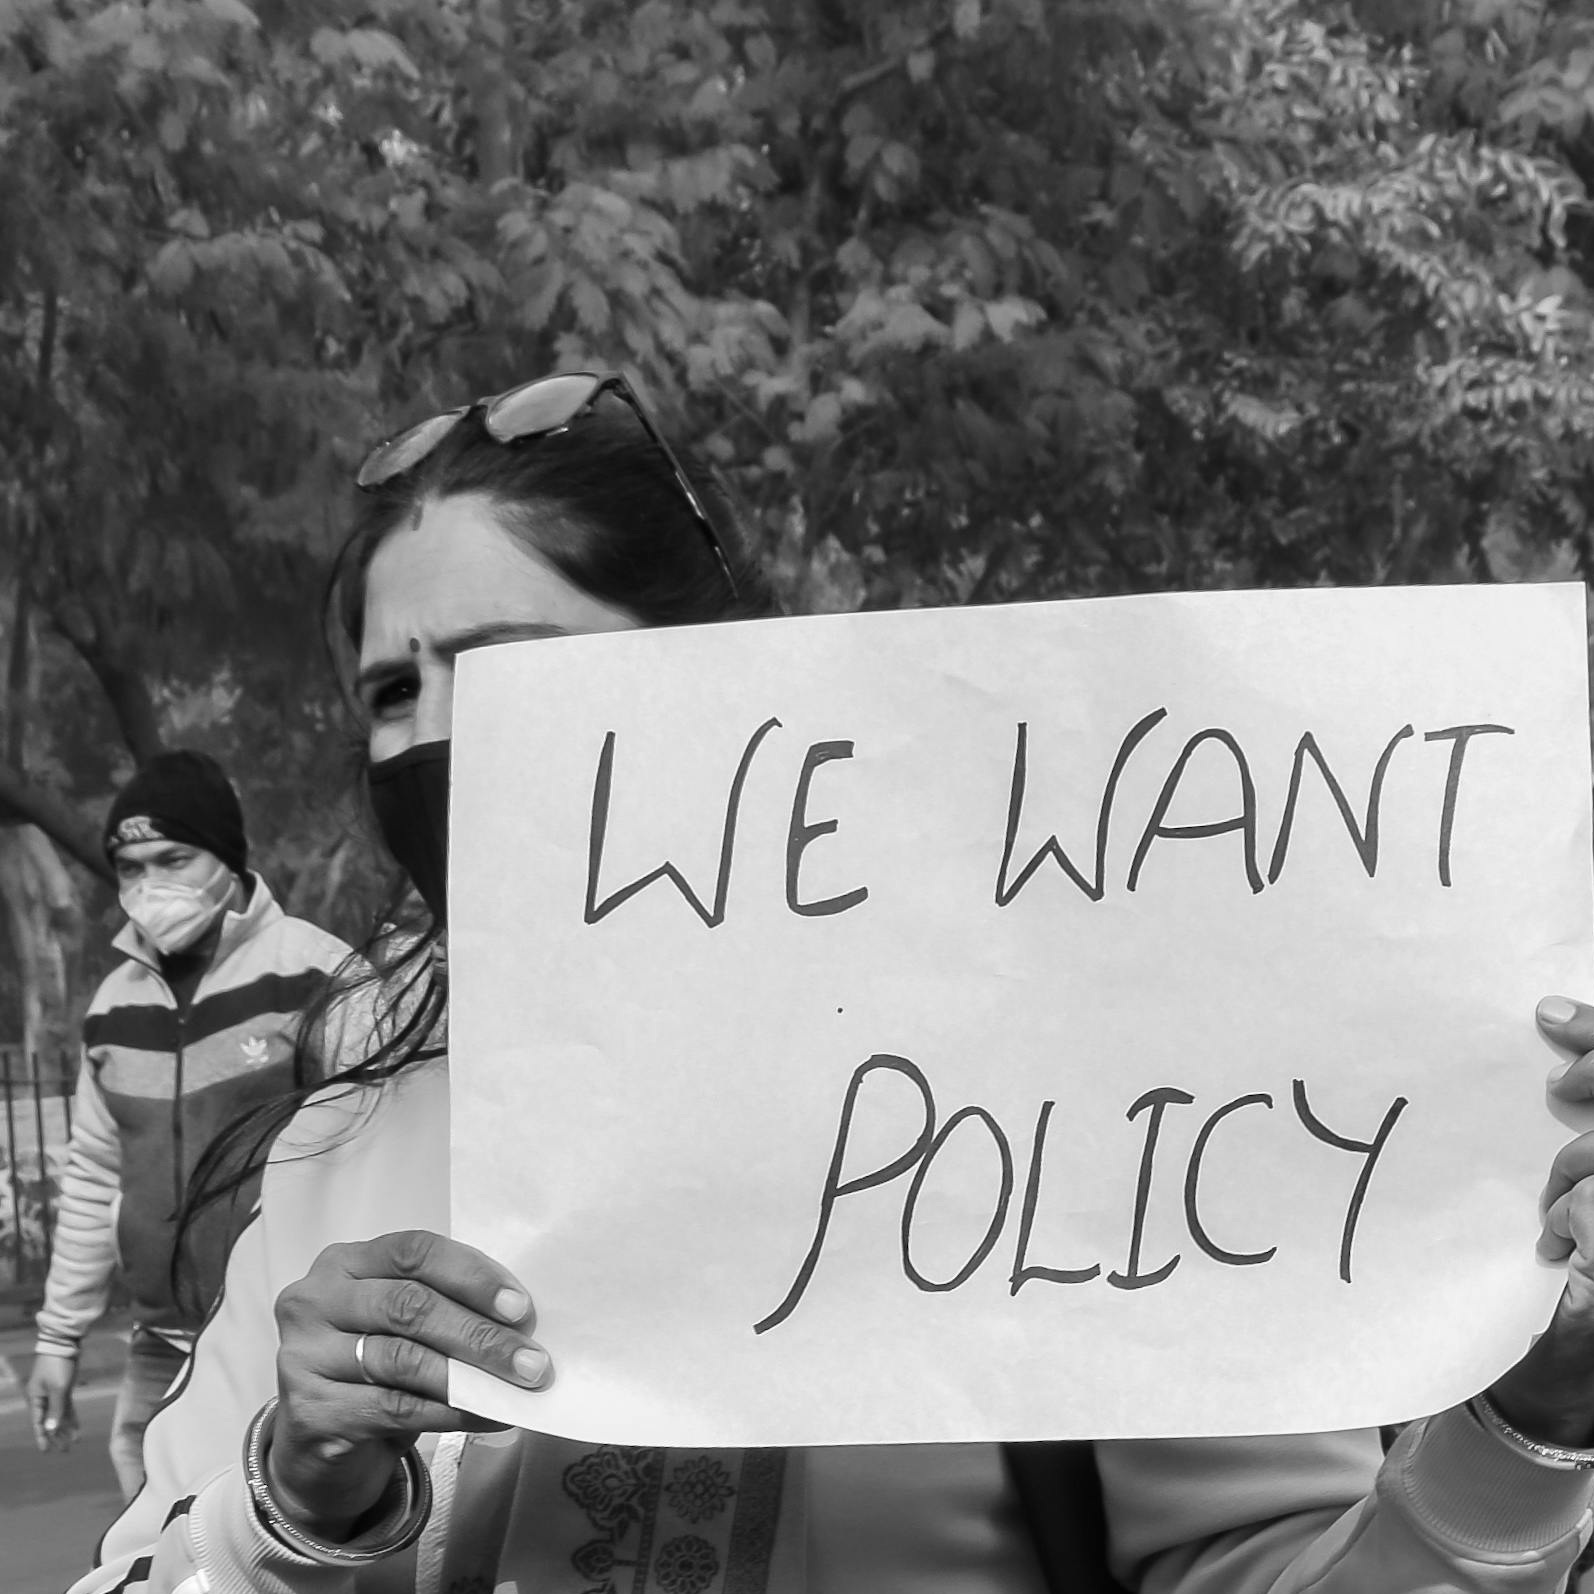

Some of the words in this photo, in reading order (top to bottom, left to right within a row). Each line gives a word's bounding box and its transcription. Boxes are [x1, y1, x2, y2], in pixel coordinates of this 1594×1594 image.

[583, 716, 869, 928] WE
[995, 706, 1515, 907] WANT
[752, 1053, 1409, 1335] POLICY
